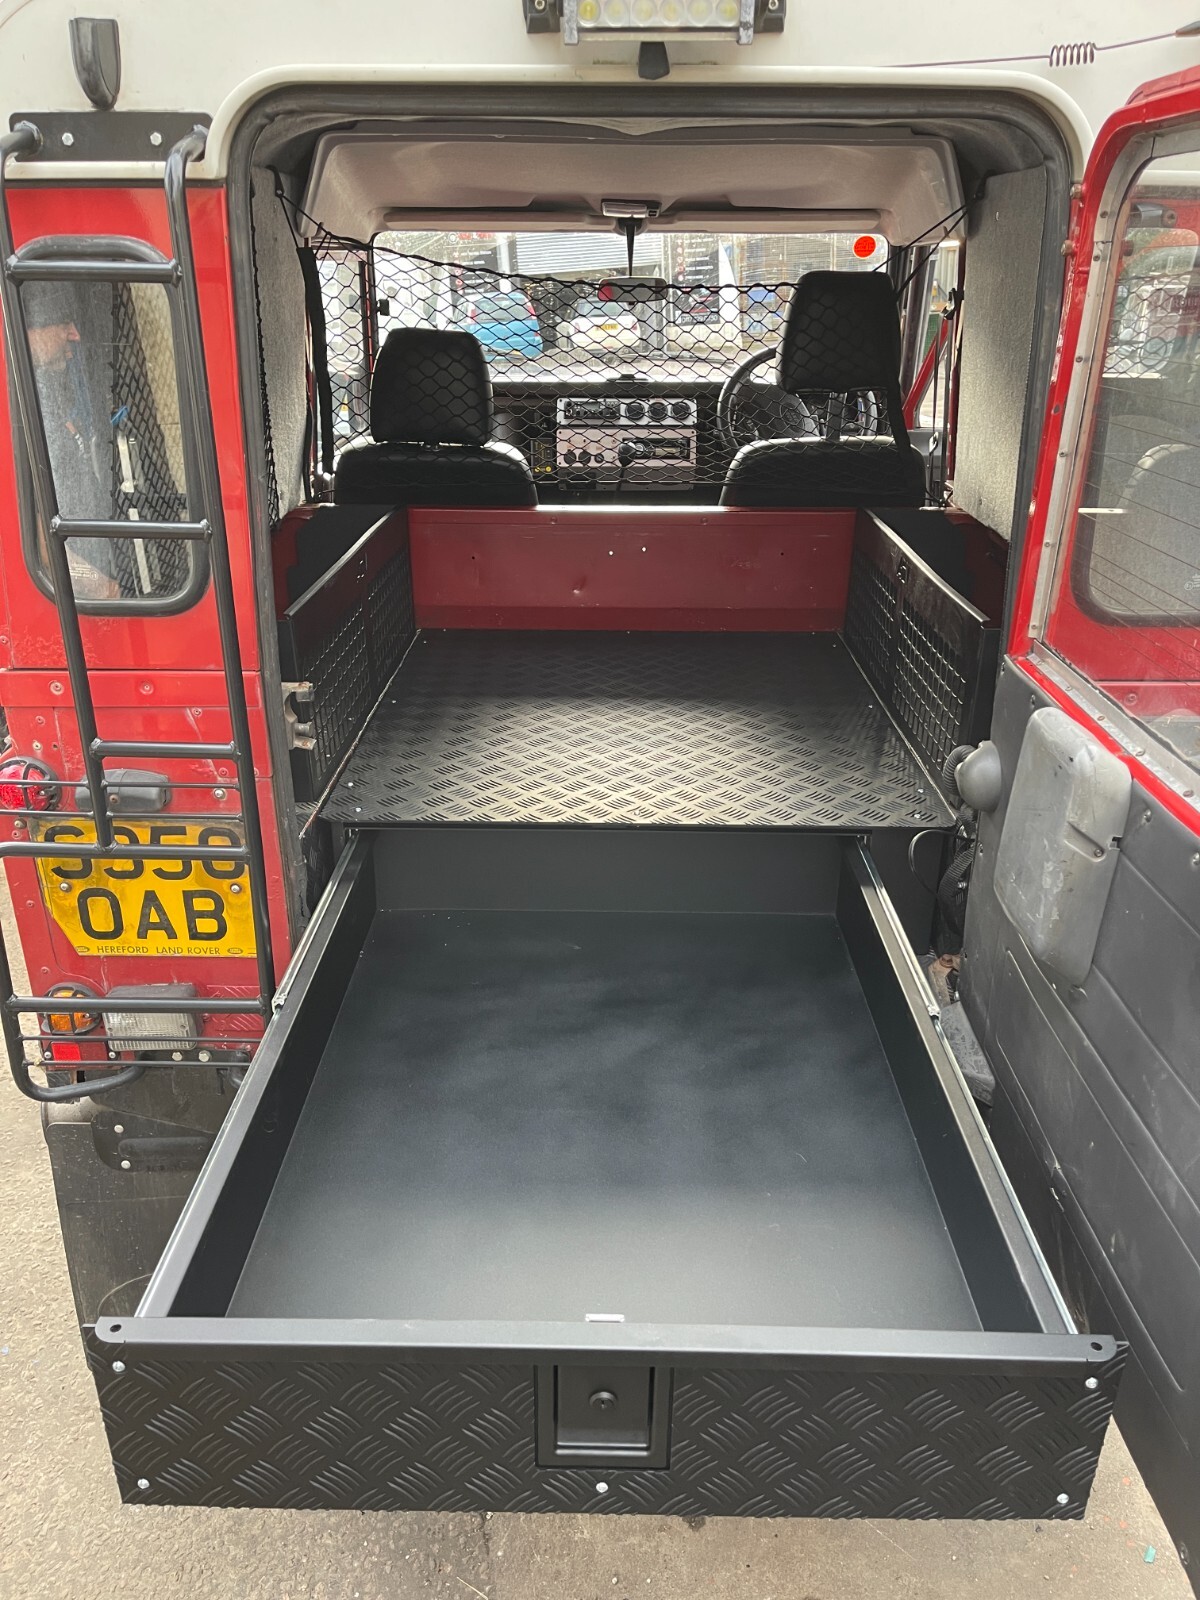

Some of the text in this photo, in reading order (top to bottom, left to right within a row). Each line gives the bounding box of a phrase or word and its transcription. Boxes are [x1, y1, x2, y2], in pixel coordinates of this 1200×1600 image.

[77, 887, 228, 941] OAB
[97, 945, 149, 954] HEREFORD
[156, 946, 183, 954] LAND
[187, 946, 221, 955] ROVER
